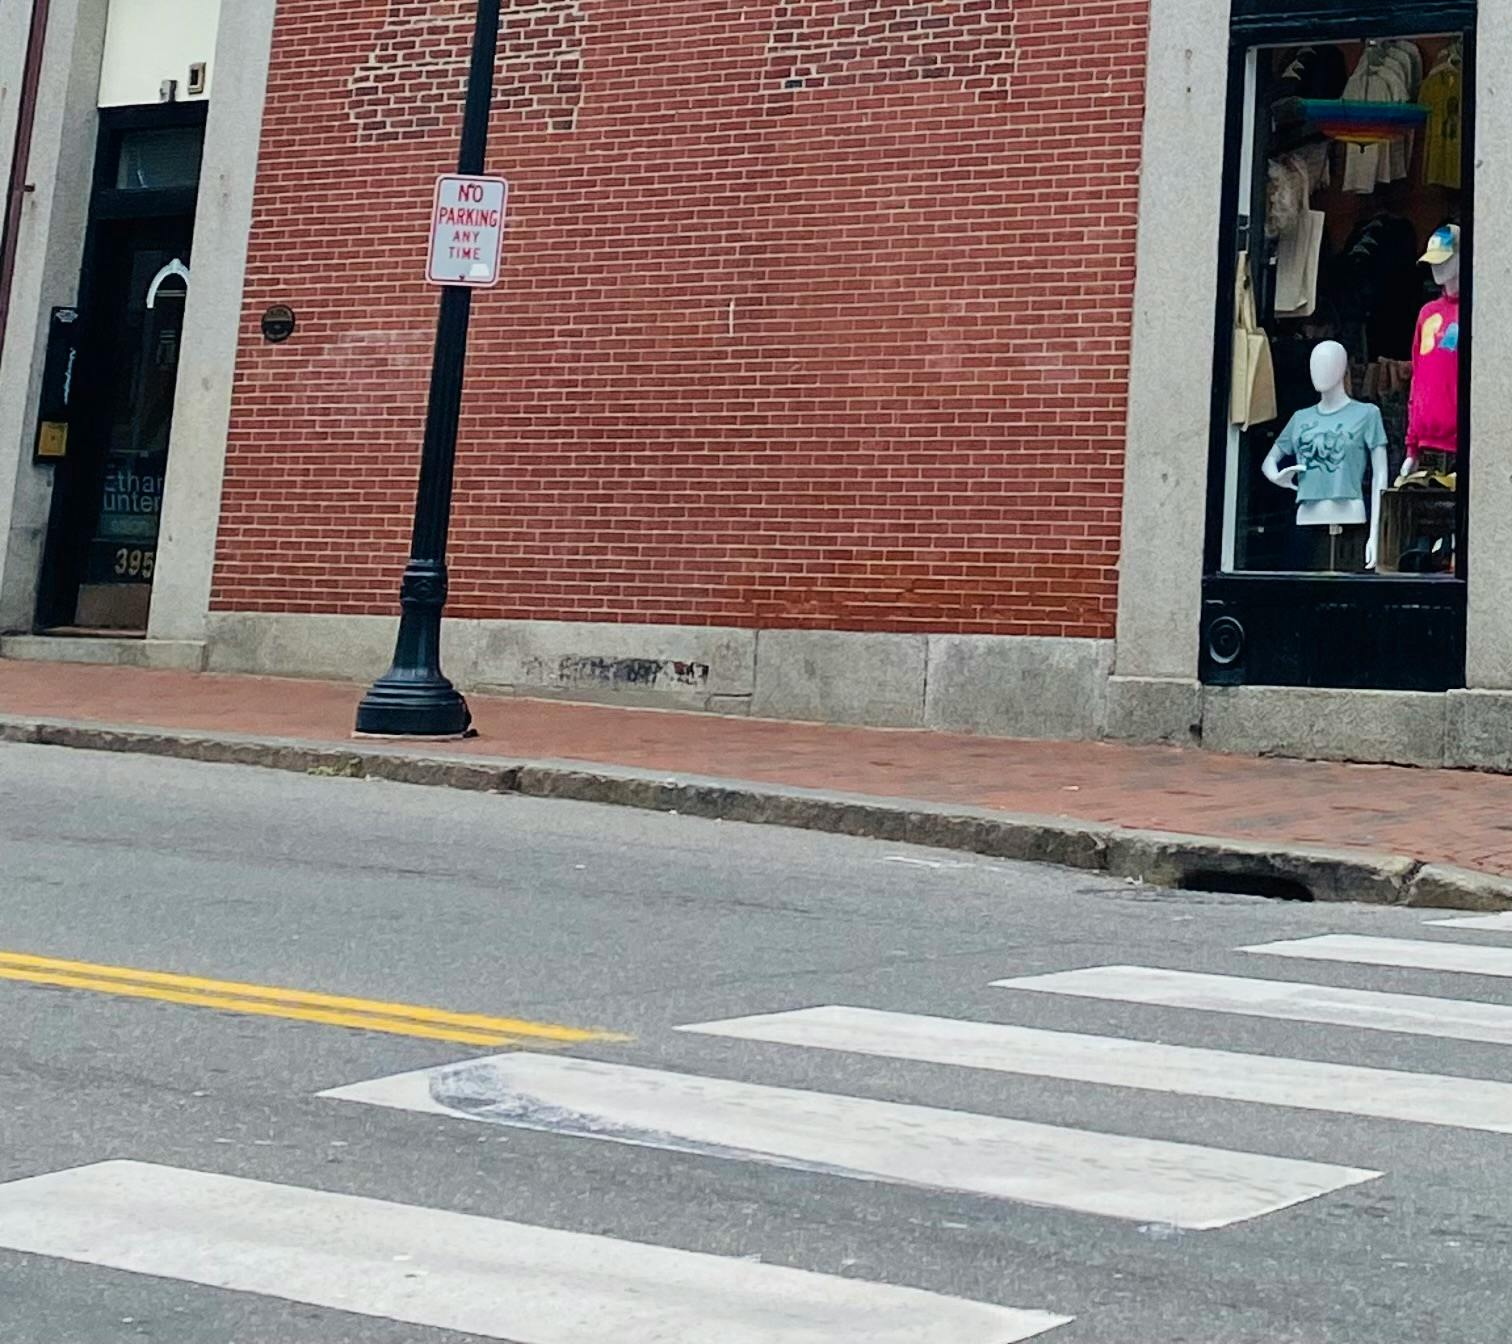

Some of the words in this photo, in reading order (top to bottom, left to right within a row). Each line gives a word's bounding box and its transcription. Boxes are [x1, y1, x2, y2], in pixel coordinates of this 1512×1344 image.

[458, 184, 484, 203] NO
[438, 207, 498, 228] PARKING
[452, 230, 480, 243] ANY
[449, 246, 481, 261] TIME
[114, 548, 154, 578] 395
